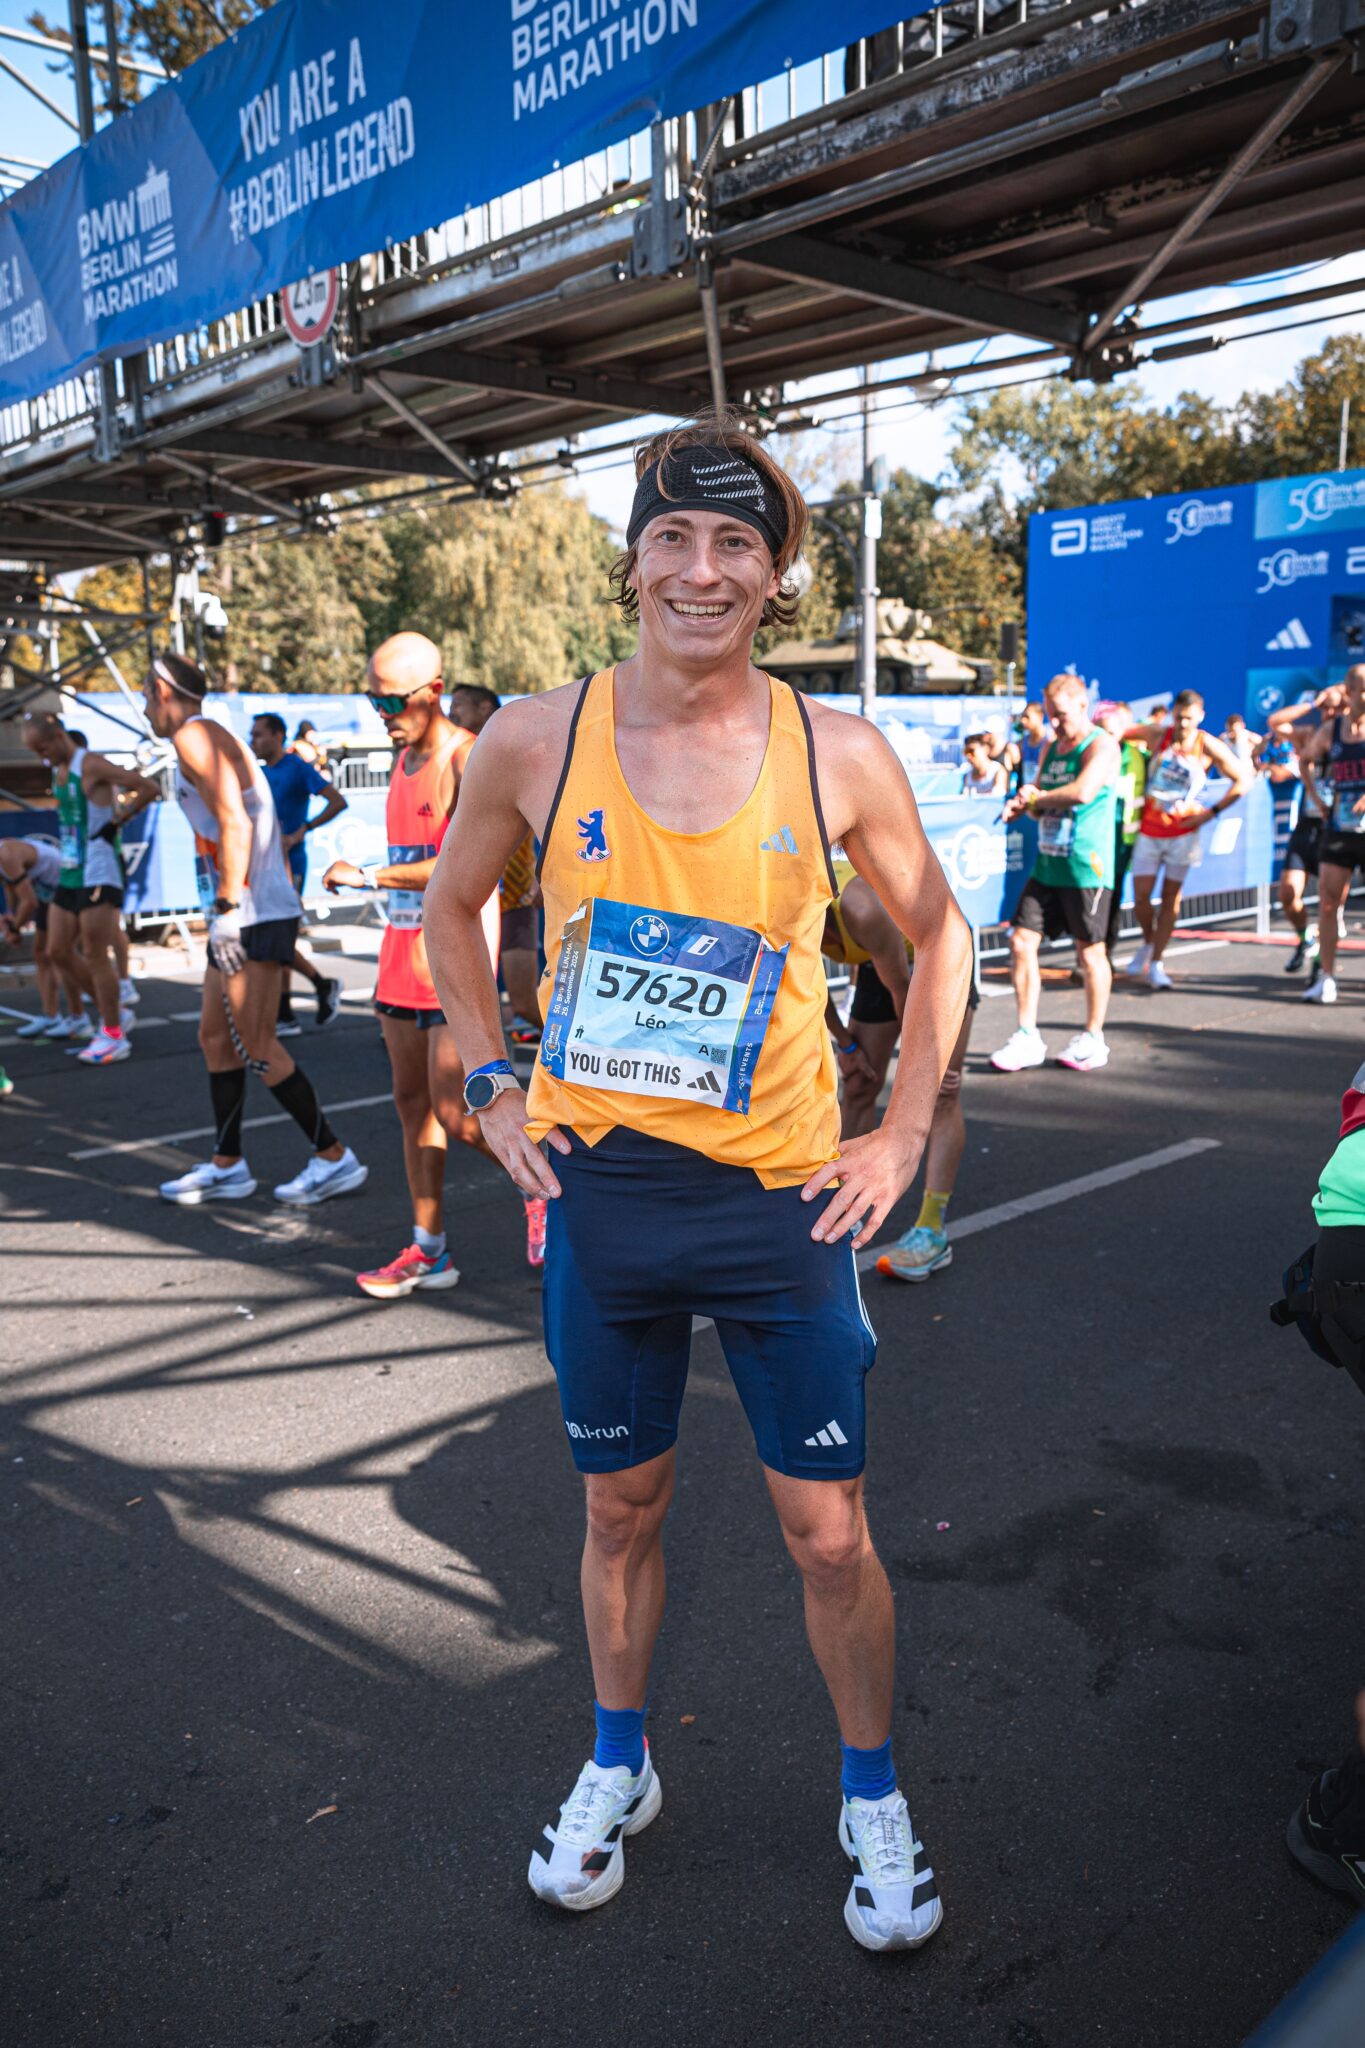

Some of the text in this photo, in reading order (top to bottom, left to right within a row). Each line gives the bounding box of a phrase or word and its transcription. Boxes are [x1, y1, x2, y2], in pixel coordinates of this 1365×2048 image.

[513, 0, 698, 121] MARATHON
[239, 37, 366, 162] YOU ARE A
[229, 96, 415, 244] #BERLINLEGEND
[77, 190, 135, 260] BMW
[81, 239, 141, 292] BERLIN
[83, 257, 178, 326] MARATHON
[596, 961, 727, 1017] 57620
[570, 1052, 682, 1086] YOU GOT THIS
[698, 1045, 710, 1057] A
